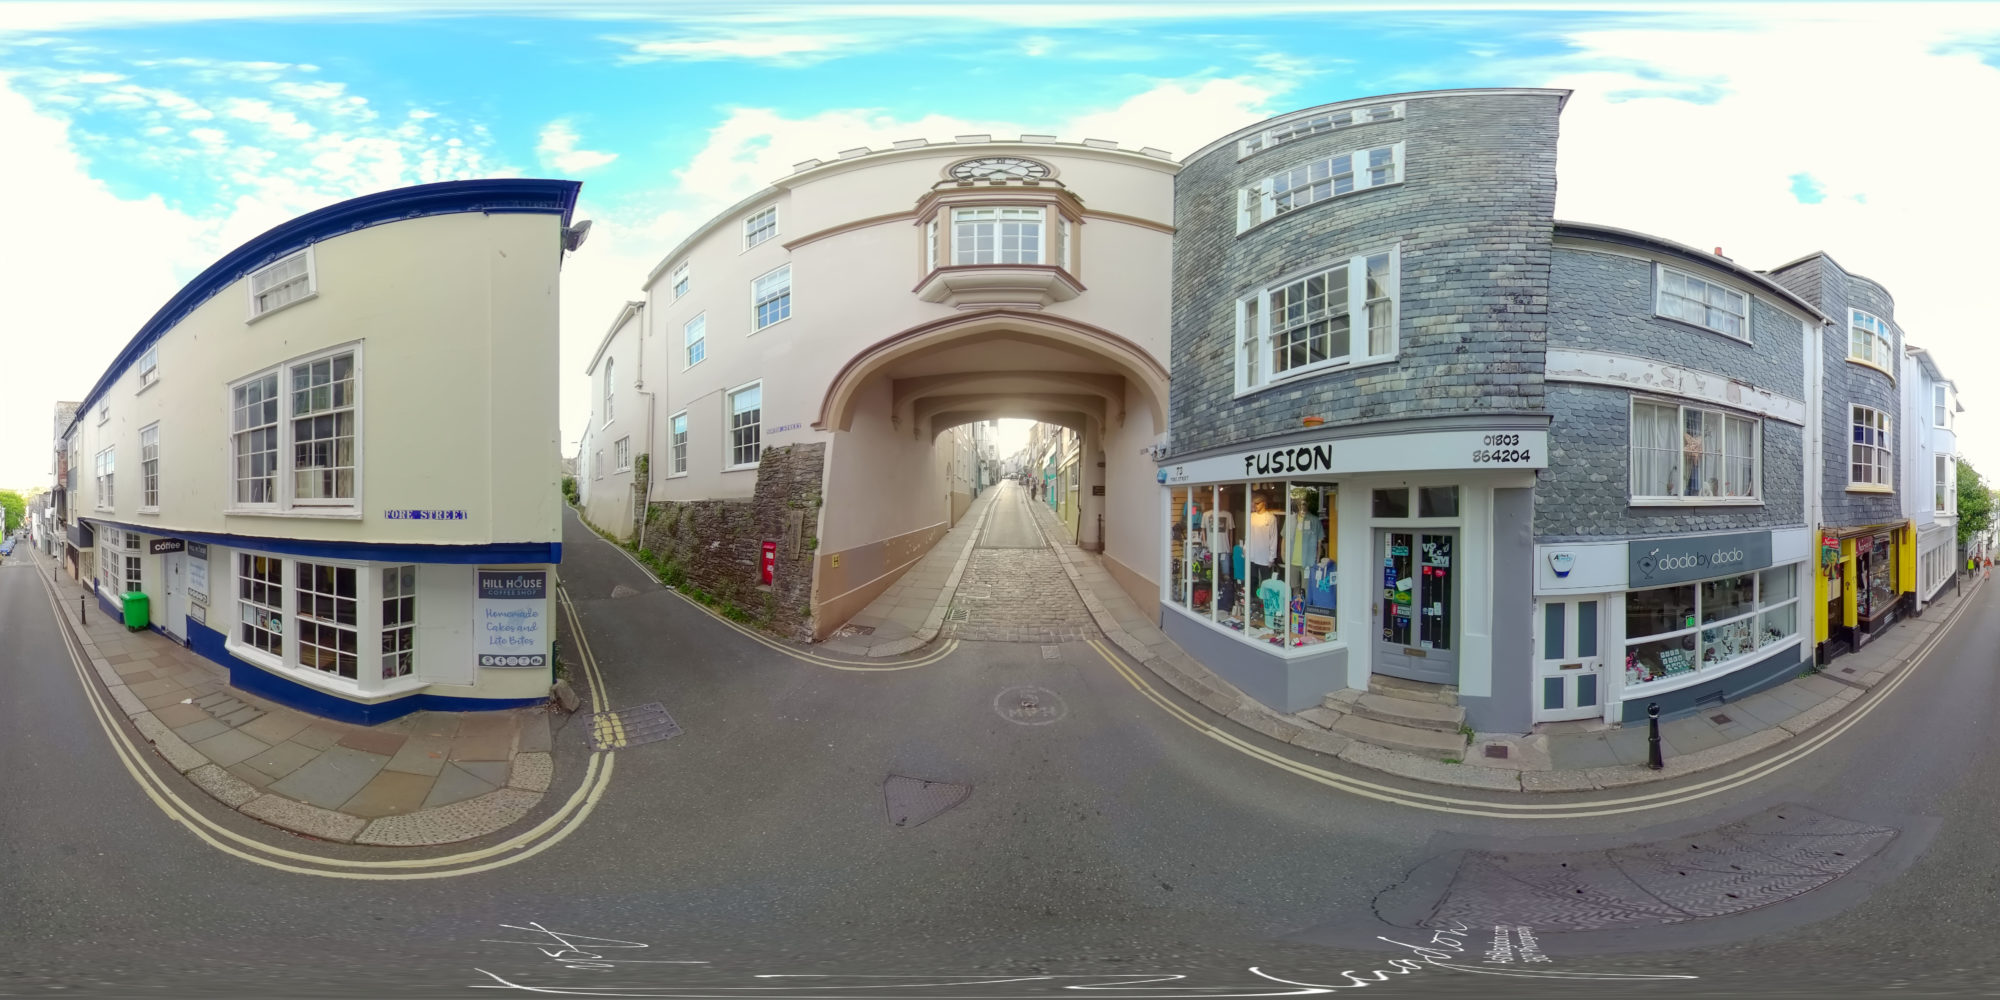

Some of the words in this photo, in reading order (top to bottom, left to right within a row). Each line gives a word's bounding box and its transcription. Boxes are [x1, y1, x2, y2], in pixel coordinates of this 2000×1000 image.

[1483, 434, 1519, 446] 01803
[1244, 444, 1332, 477] FUSION
[1472, 449, 1530, 463] 864204
[384, 509, 413, 519] FORE
[420, 509, 468, 520] STREET
[154, 541, 181, 551] coffee
[482, 579, 503, 588] HILL
[506, 579, 542, 588] HOUSE
[485, 608, 538, 618] Homemade
[487, 622, 515, 632] Cakes
[517, 622, 536, 632] and
